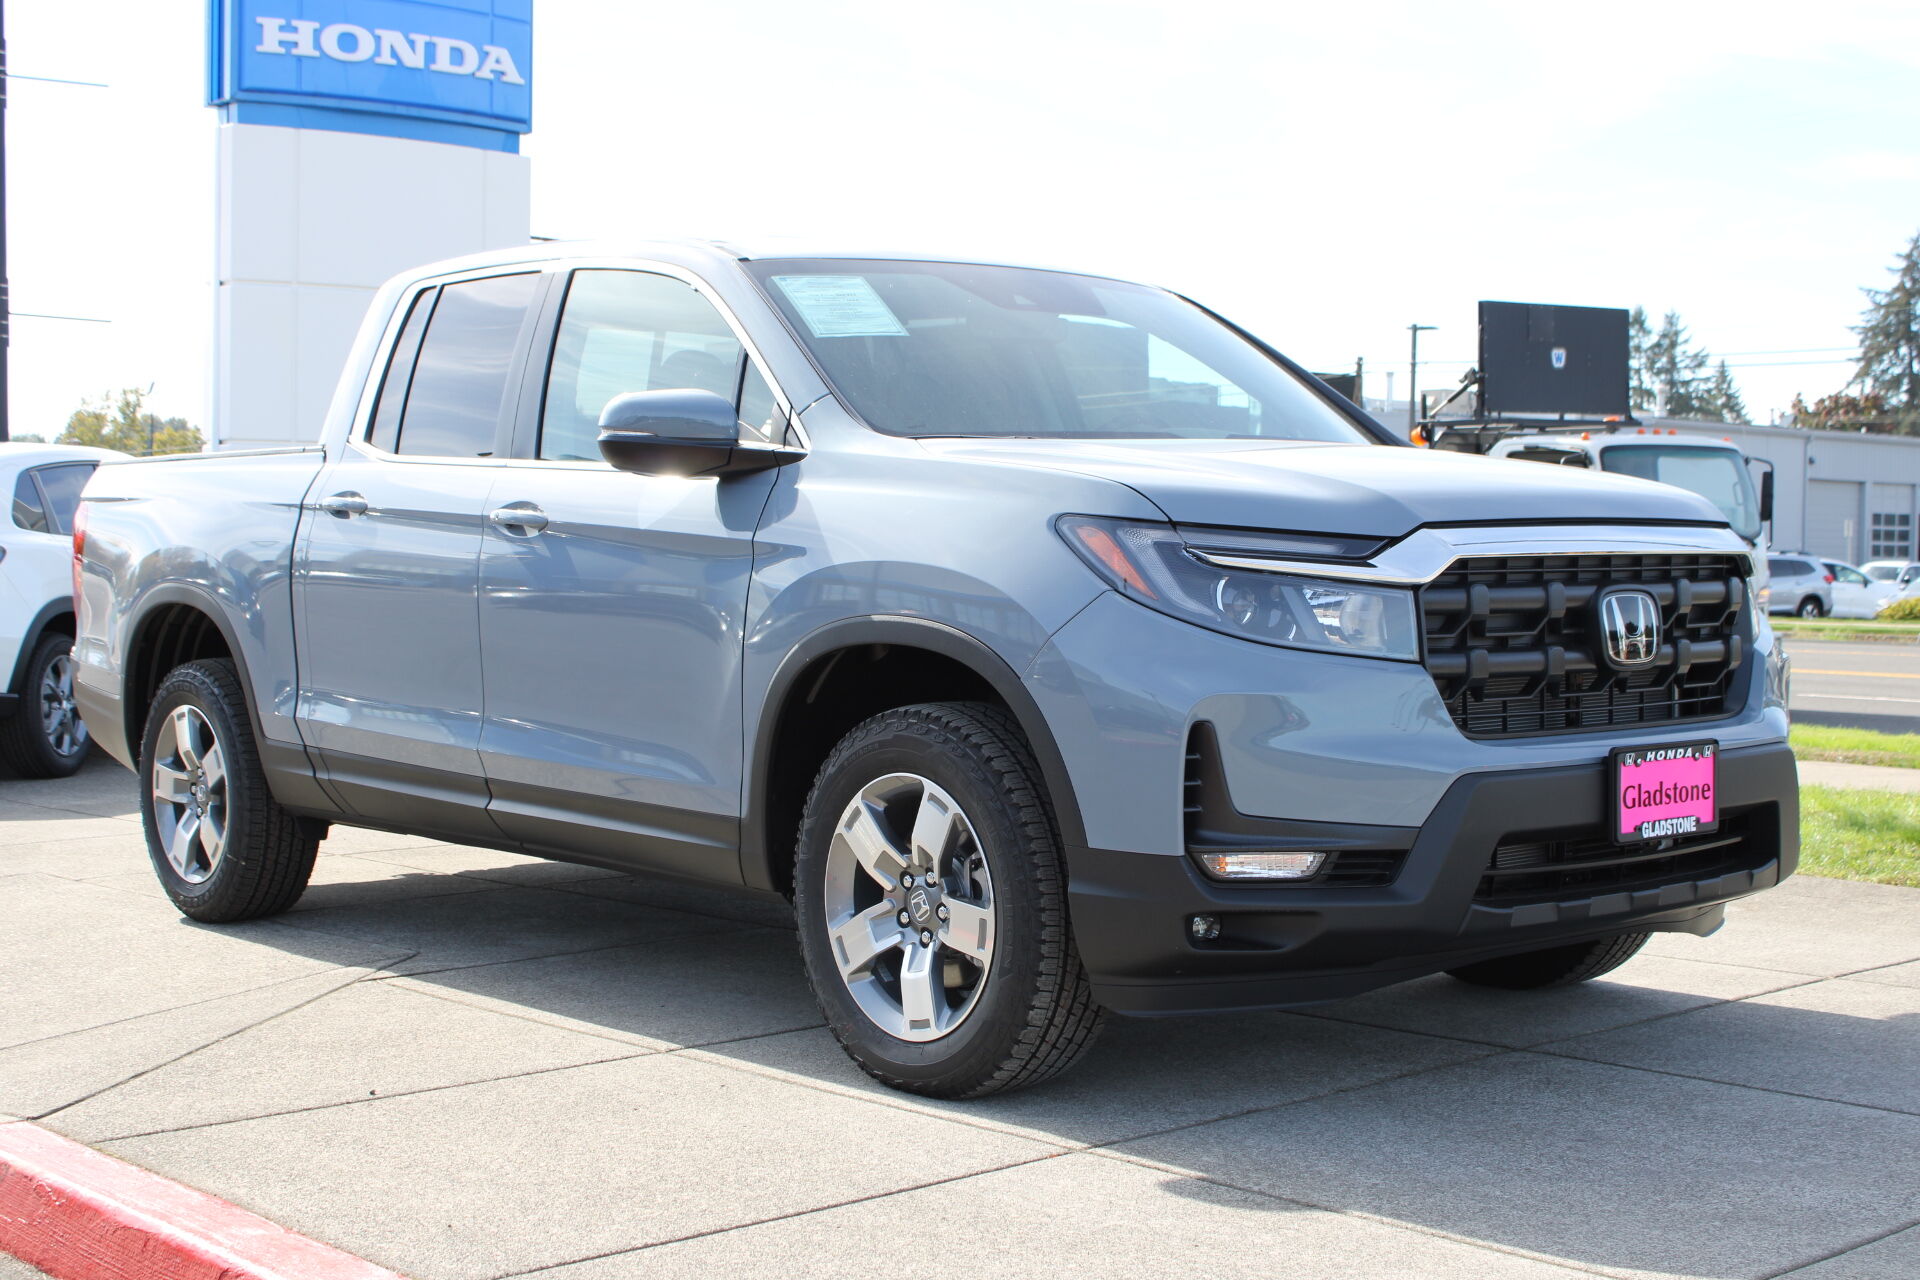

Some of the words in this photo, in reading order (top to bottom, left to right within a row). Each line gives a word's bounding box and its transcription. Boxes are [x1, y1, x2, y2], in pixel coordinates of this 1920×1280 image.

[255, 16, 526, 85] HONDA
[1646, 747, 1692, 762] HONDA
[1622, 781, 1711, 809] Gladstone
[1642, 816, 1696, 838] GLADSTONE
